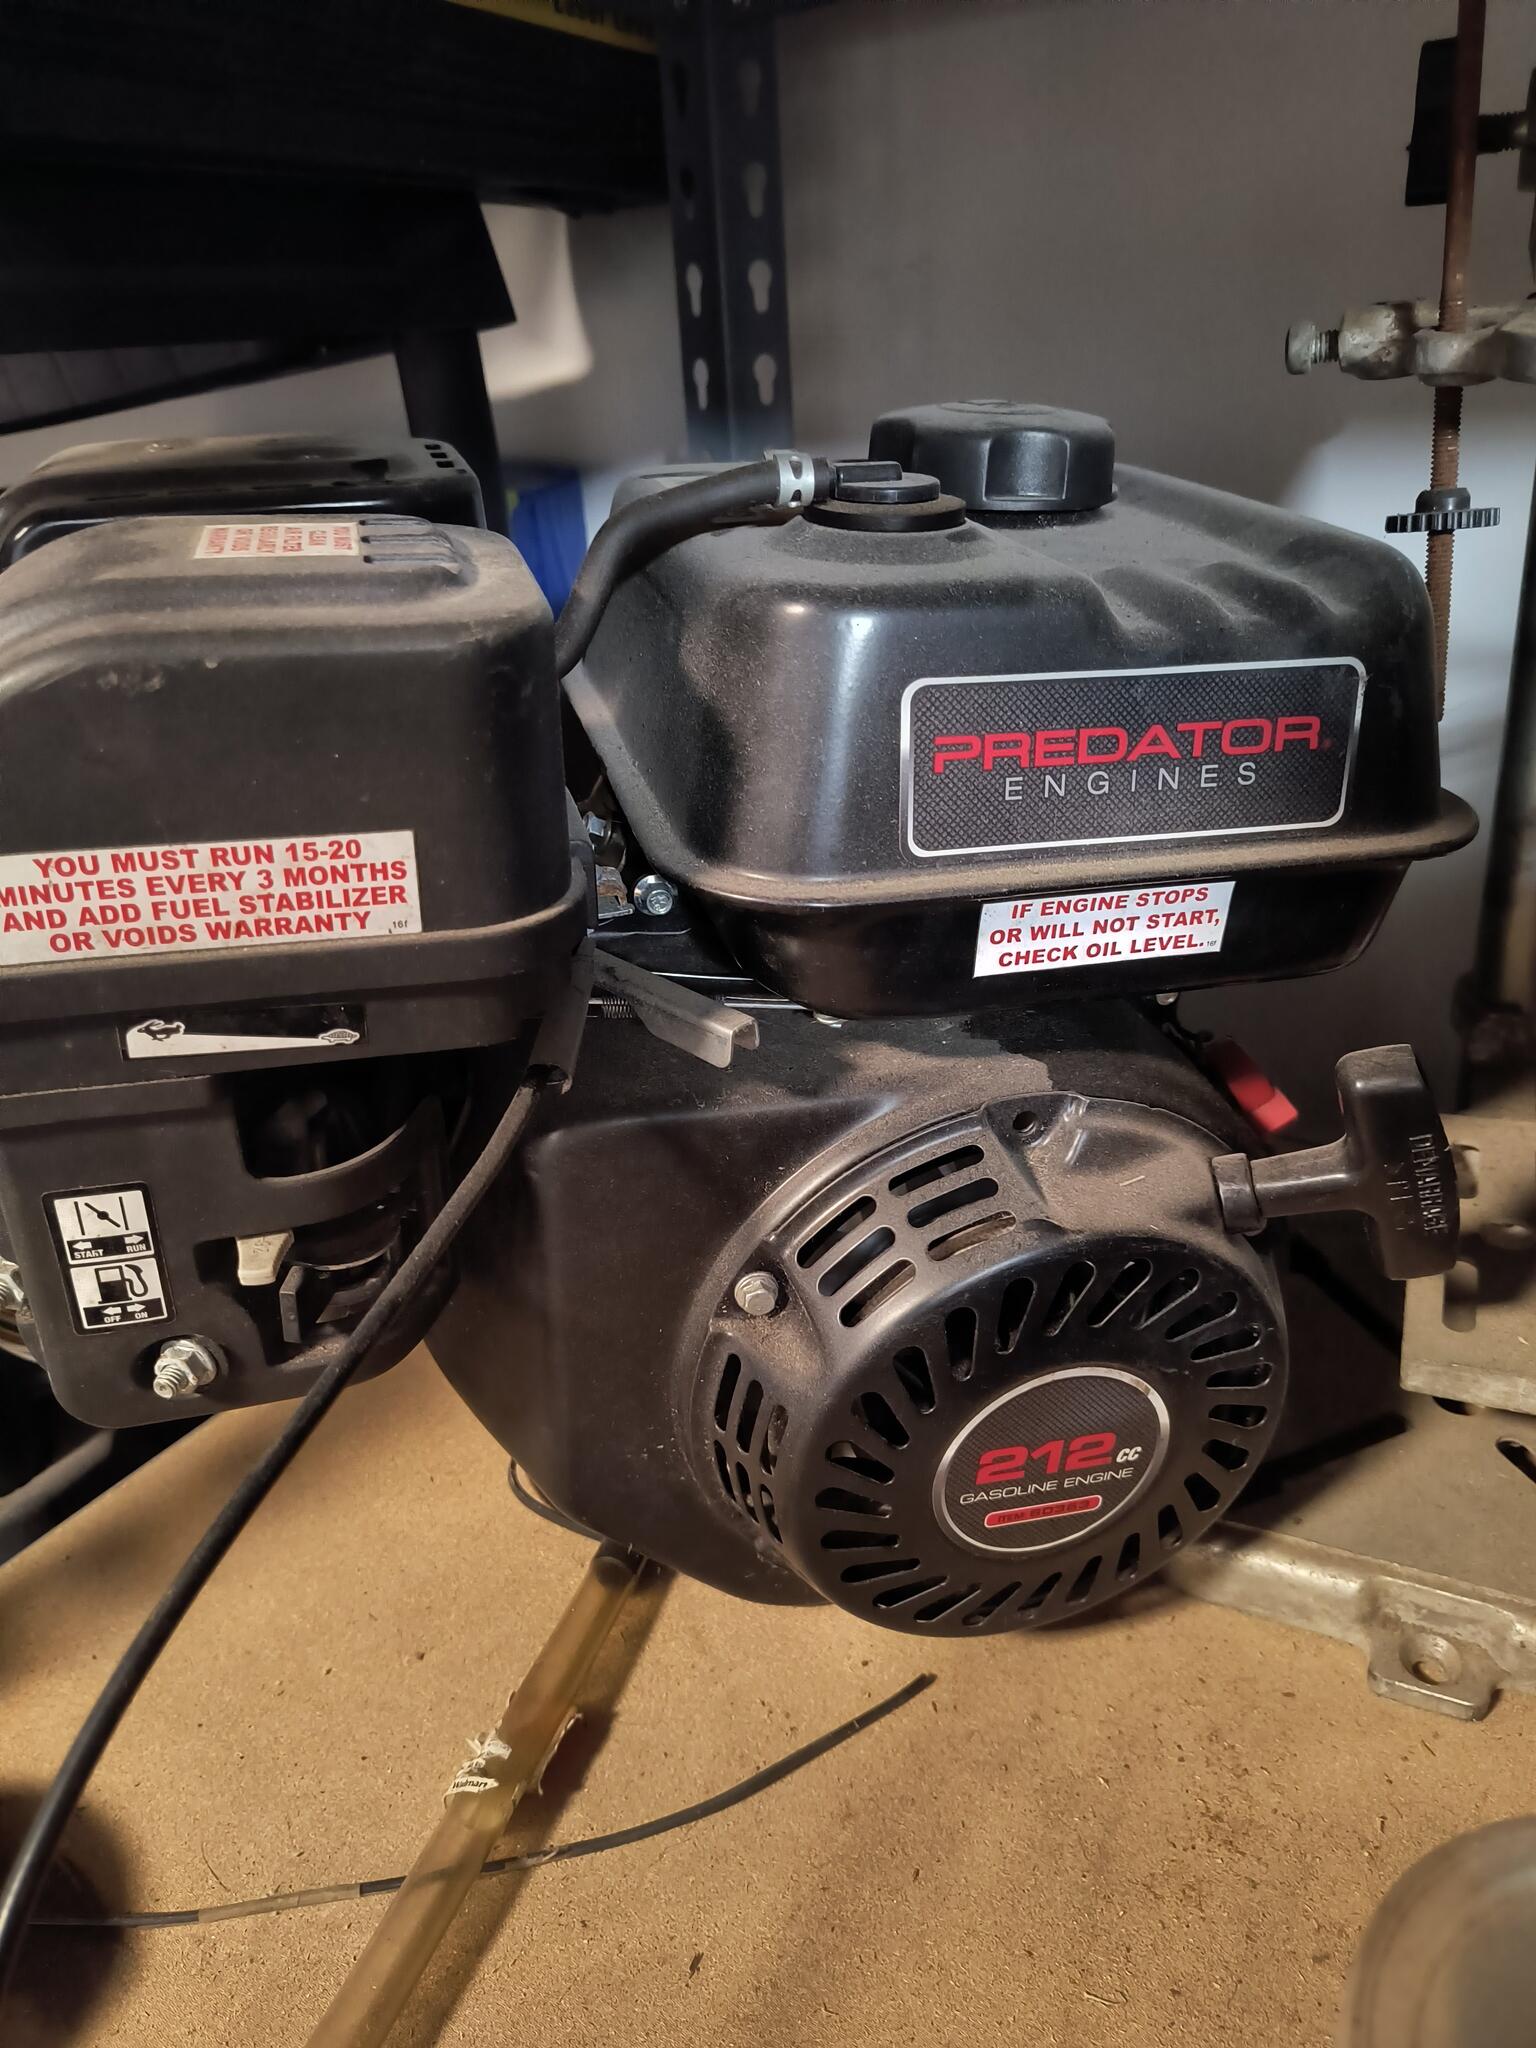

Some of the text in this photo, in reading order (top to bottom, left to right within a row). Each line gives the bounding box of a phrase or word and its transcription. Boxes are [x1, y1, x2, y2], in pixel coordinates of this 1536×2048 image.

[932, 715, 1321, 775] PREDATOR
[1004, 761, 1257, 801] ENGINES
[32, 839, 362, 878] YOU MUST RUN 15-20
[0, 860, 407, 907] MINUTES EVERY 3 MONTHS
[3, 885, 408, 932] AND ADD FUEL STABILIZER
[1011, 887, 1208, 919] IF ENGINE STOPS
[50, 911, 371, 953] OR VOIDS WARRANTY
[989, 909, 1220, 945] OR WILL NOT START,
[999, 934, 1204, 967] CHECK OIL LEVEL.
[74, 1249, 104, 1259] START
[125, 1243, 147, 1253] RUN
[104, 1315, 122, 1324] OFF
[134, 1311, 148, 1320] ON
[975, 1432, 1117, 1485] 212
[959, 1467, 1135, 1505] GASOLINE ENGINE
